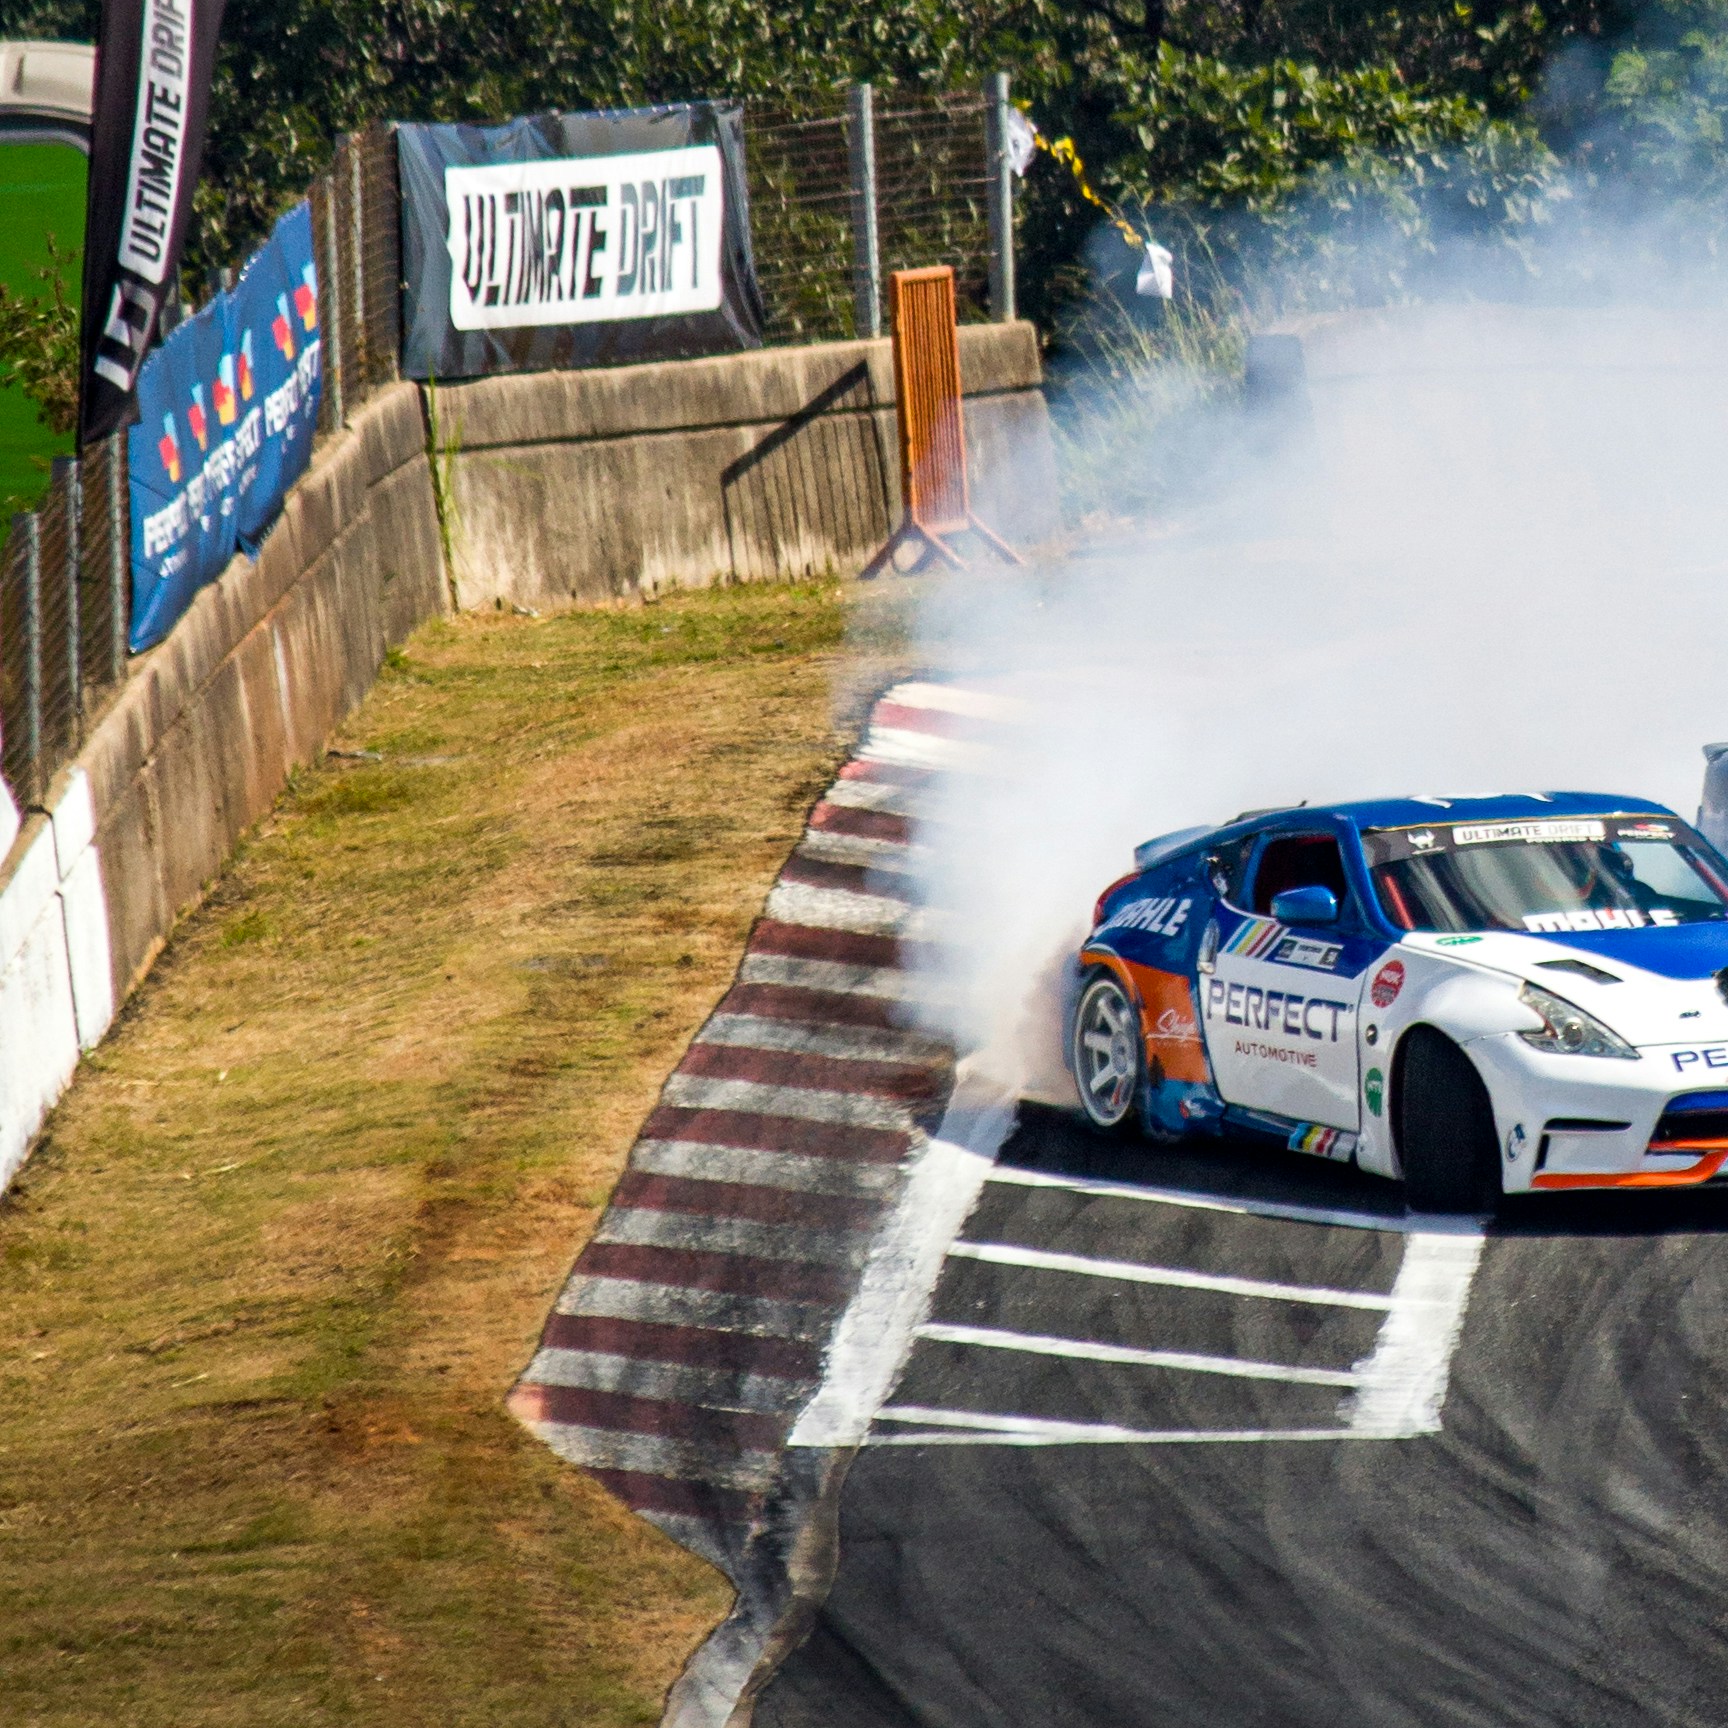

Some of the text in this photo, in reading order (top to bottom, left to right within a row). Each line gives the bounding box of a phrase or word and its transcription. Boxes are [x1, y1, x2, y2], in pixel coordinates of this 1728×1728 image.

[128, 81, 182, 264] ULTIMATE
[462, 174, 706, 308] ULTIMATE DRIFT
[1462, 822, 1594, 841] ULTIMATE DRIFT
[1206, 978, 1349, 1043] PERFECT
[1234, 1040, 1318, 1068] AUTOMOTIVE
